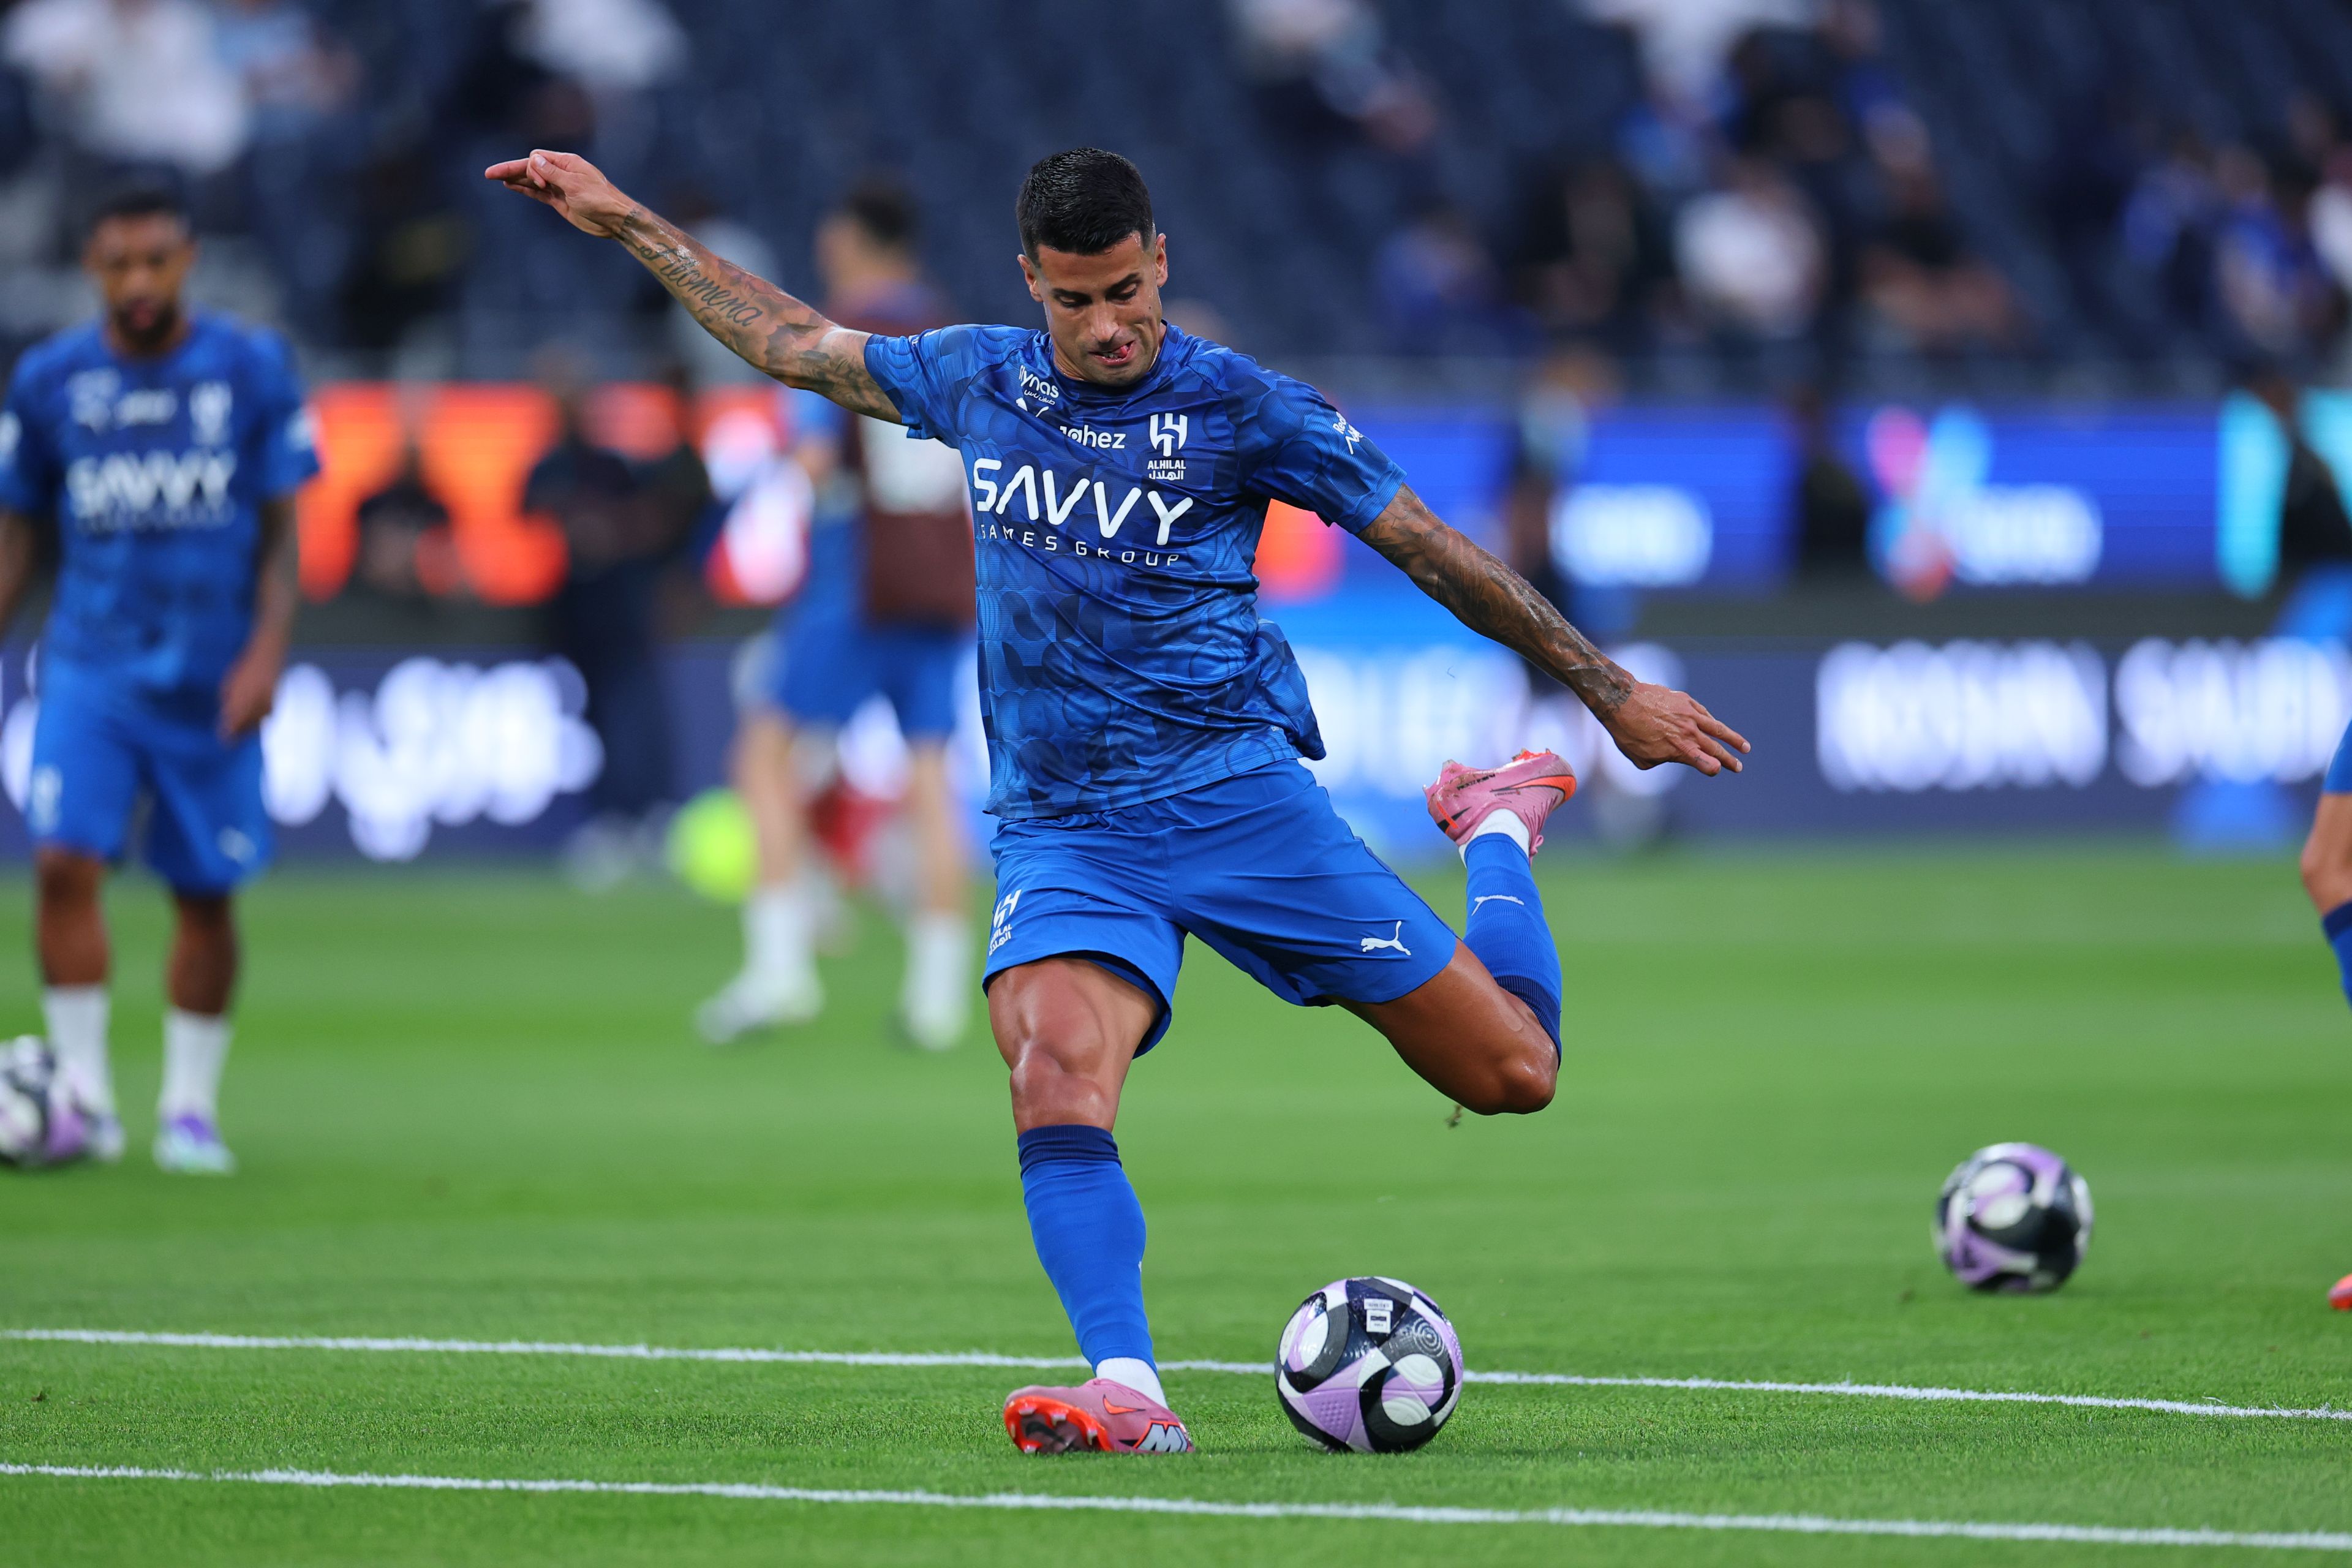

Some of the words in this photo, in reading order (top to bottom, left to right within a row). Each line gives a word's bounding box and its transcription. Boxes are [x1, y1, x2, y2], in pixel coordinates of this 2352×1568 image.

[1147, 459, 1186, 470] ALHILAL
[1148, 470, 1184, 481] الهلال
[974, 458, 1194, 546] SAVVY
[1076, 541, 1180, 567] GROUP
